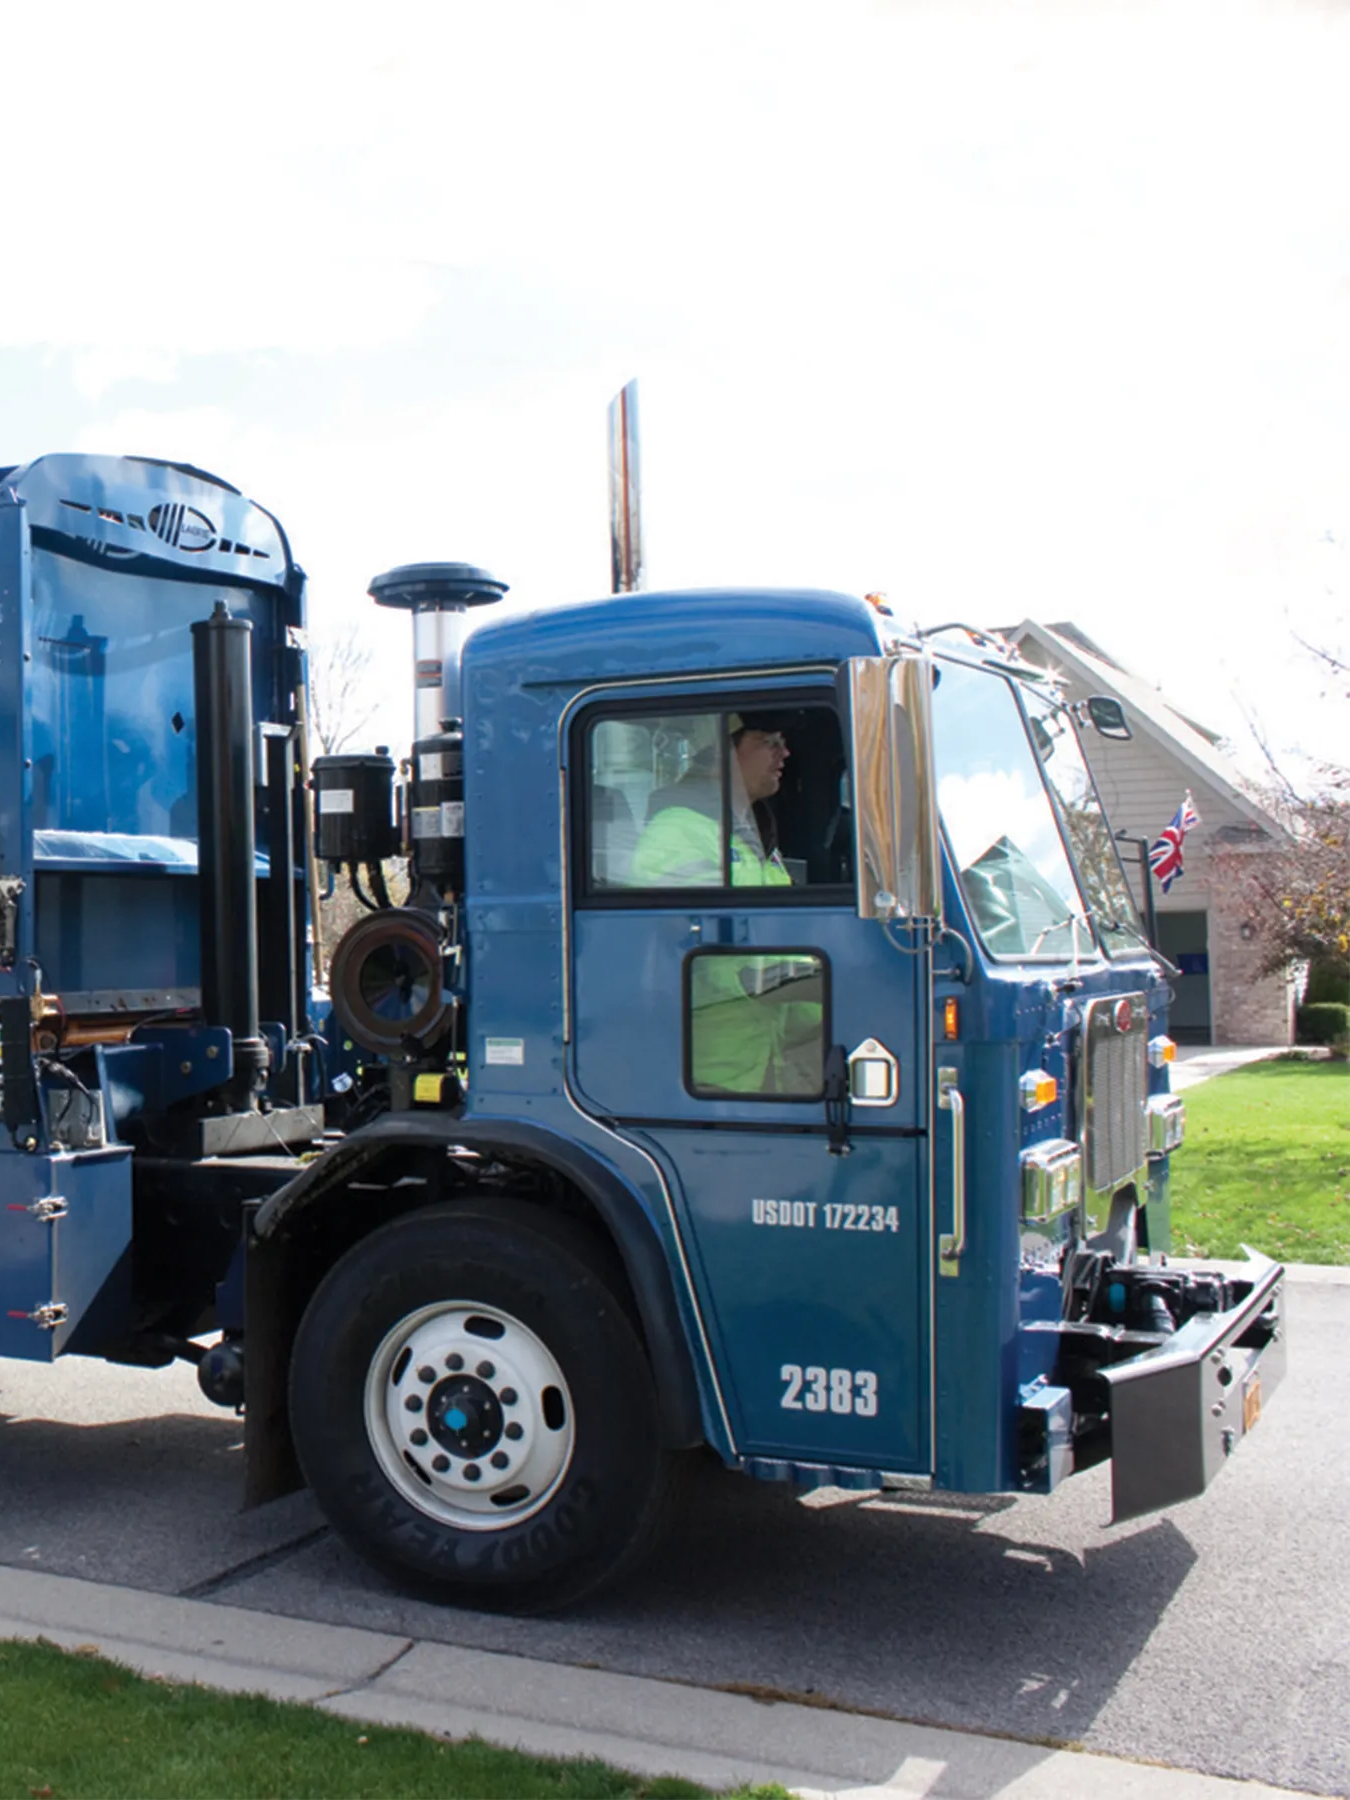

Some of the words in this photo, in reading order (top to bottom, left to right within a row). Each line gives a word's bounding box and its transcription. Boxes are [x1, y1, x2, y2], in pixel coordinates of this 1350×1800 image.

[752, 1199, 817, 1228] USDOT
[823, 1203, 899, 1233] 172234
[780, 1363, 878, 1417] 2383
